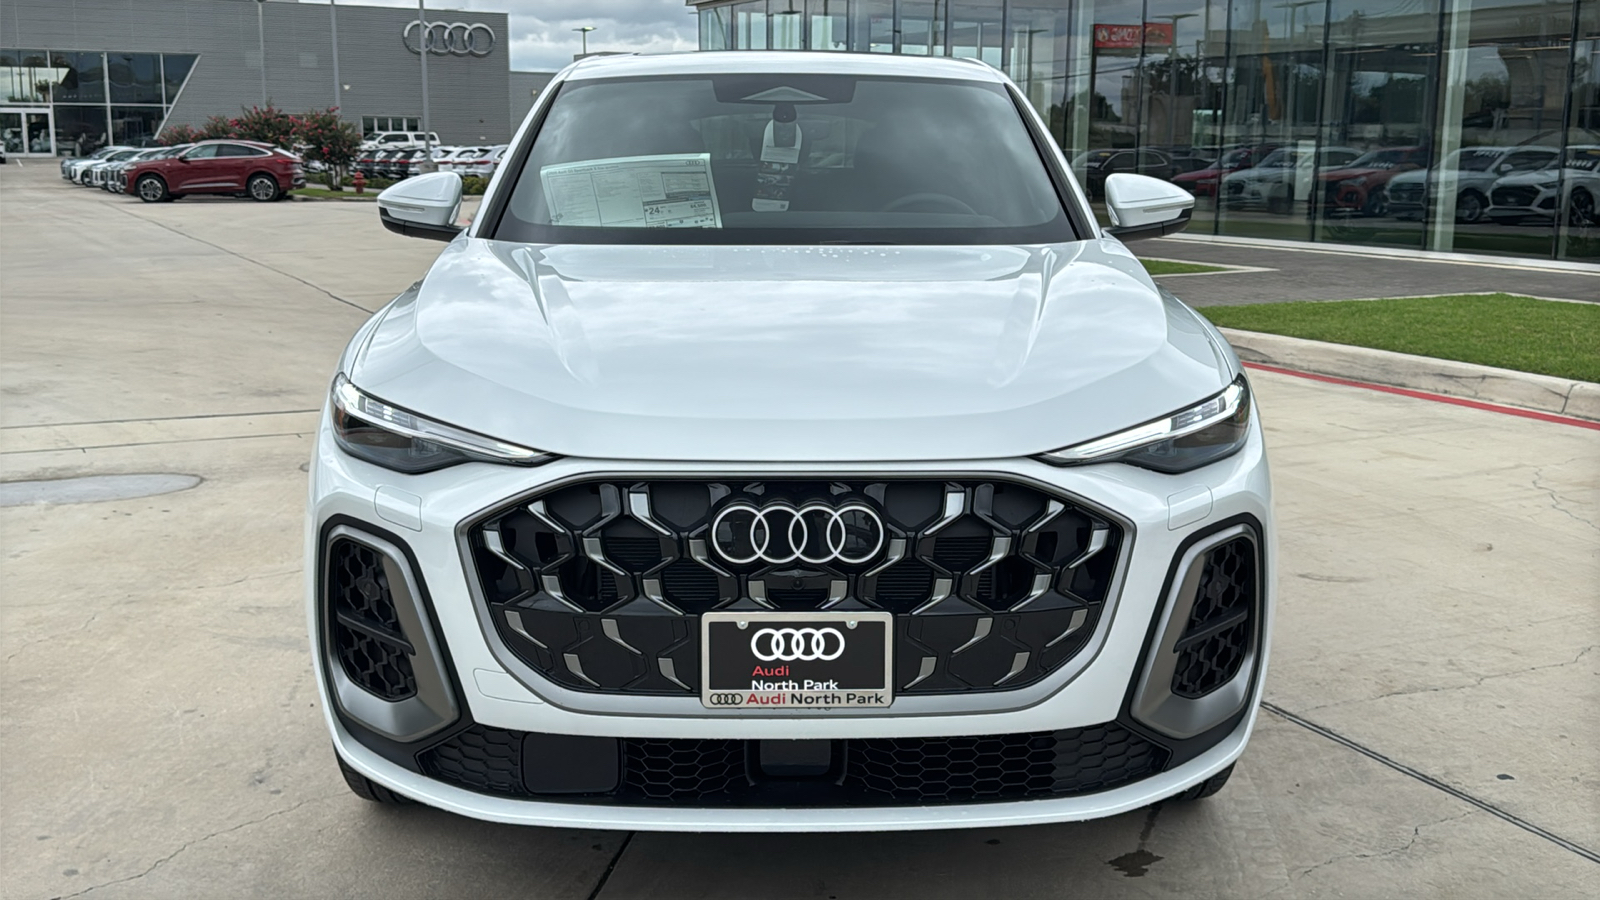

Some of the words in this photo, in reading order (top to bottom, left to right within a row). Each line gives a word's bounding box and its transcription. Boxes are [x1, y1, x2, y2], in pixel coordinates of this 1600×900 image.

[649, 206, 660, 215] 24
[752, 665, 790, 677] Audi
[751, 680, 799, 691] North
[803, 679, 839, 691] Park
[746, 693, 786, 705] Audi
[790, 693, 842, 705] North
[846, 693, 885, 705] Park
